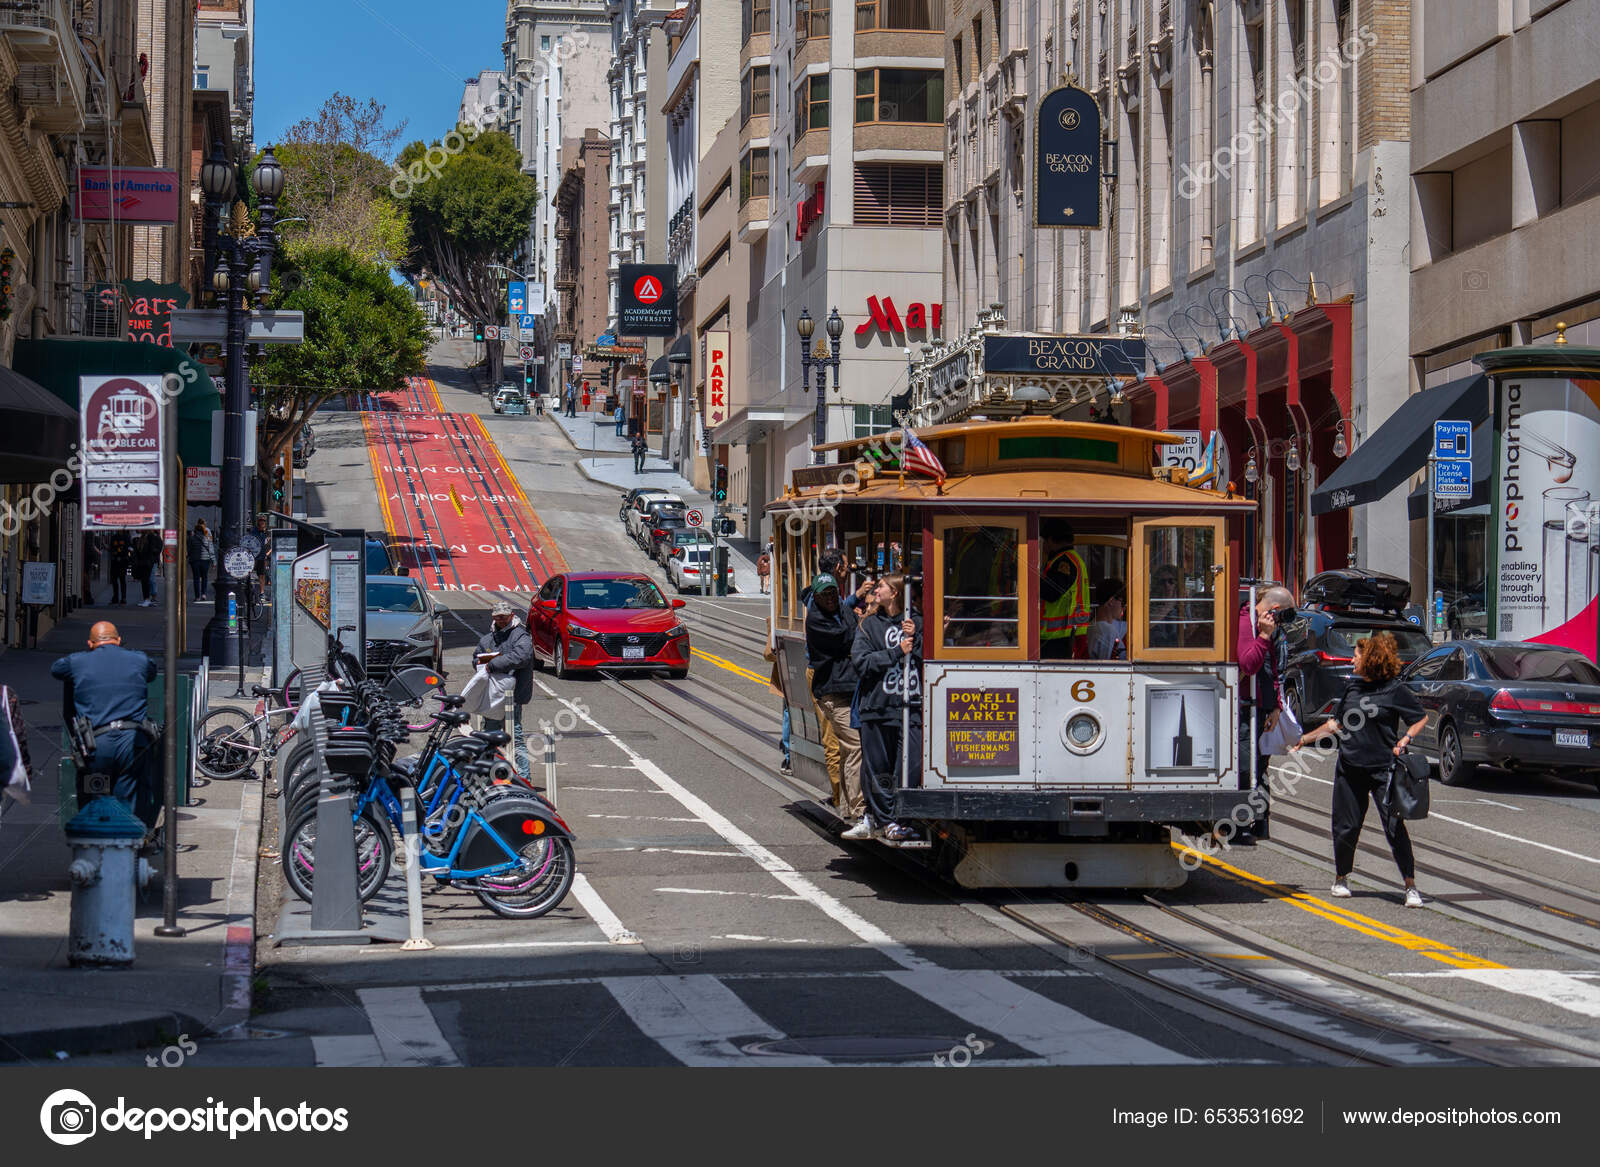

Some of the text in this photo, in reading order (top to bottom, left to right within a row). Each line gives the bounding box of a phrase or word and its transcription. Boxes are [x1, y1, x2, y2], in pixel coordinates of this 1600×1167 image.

[1045, 153, 1093, 165] BEACON
[1049, 163, 1089, 174] GRAND
[117, 178, 127, 192] of
[127, 179, 172, 193] America
[128, 319, 152, 330] FINE
[1028, 339, 1102, 358] BEACON
[1036, 355, 1095, 370] GRAND
[711, 349, 724, 407] PARK
[1437, 424, 1468, 434] Pay here
[108, 438, 136, 448] CABLE
[137, 438, 156, 448] CAR
[1168, 446, 1194, 454] LIMIT
[1438, 463, 1461, 471] Pay by
[1503, 383, 1524, 552] propharma
[1501, 561, 1538, 573] enabling
[1501, 572, 1542, 583] discovery
[1501, 582, 1533, 593] through
[1501, 593, 1546, 603] innovation
[1070, 680, 1096, 703] 6
[950, 692, 1016, 703] POWELL
[967, 703, 1000, 711] AND
[949, 711, 1017, 721] MARKET
[949, 730, 973, 742] HYDE
[986, 730, 1016, 742] BEACH
[955, 743, 1010, 752] FISHERMANS
[968, 752, 997, 760] WHARF
